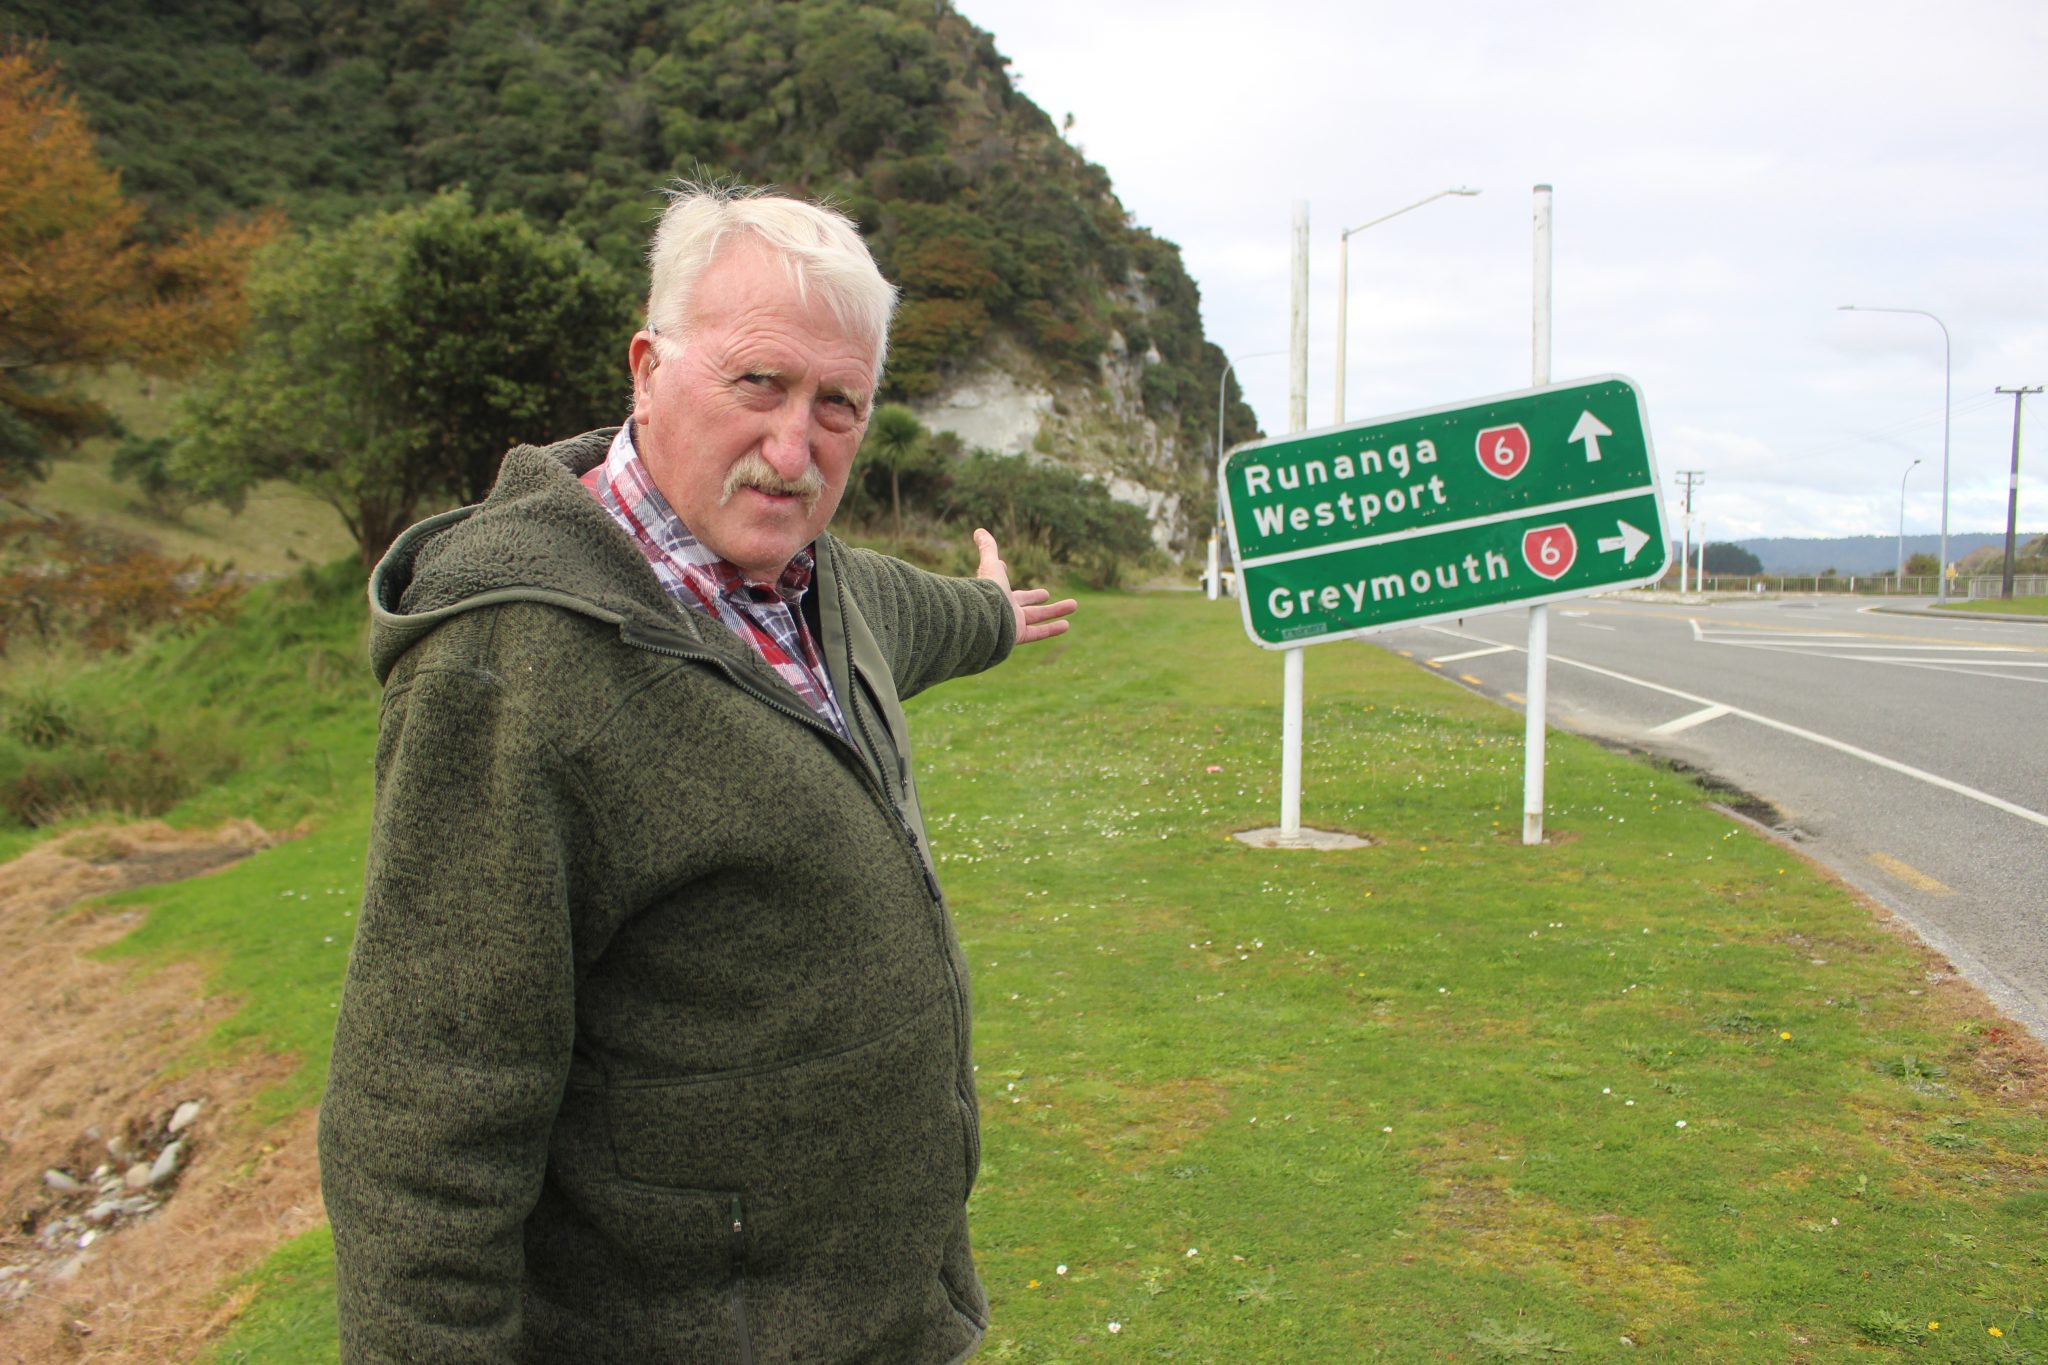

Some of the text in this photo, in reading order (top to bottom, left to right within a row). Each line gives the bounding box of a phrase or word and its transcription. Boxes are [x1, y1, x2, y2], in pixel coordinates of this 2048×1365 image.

[1244, 437, 1438, 497] Runanga
[1494, 436, 1515, 466] 6
[1253, 474, 1447, 538] Westport
[1540, 536, 1561, 565] 6
[1267, 549, 1510, 619] Greymouth
